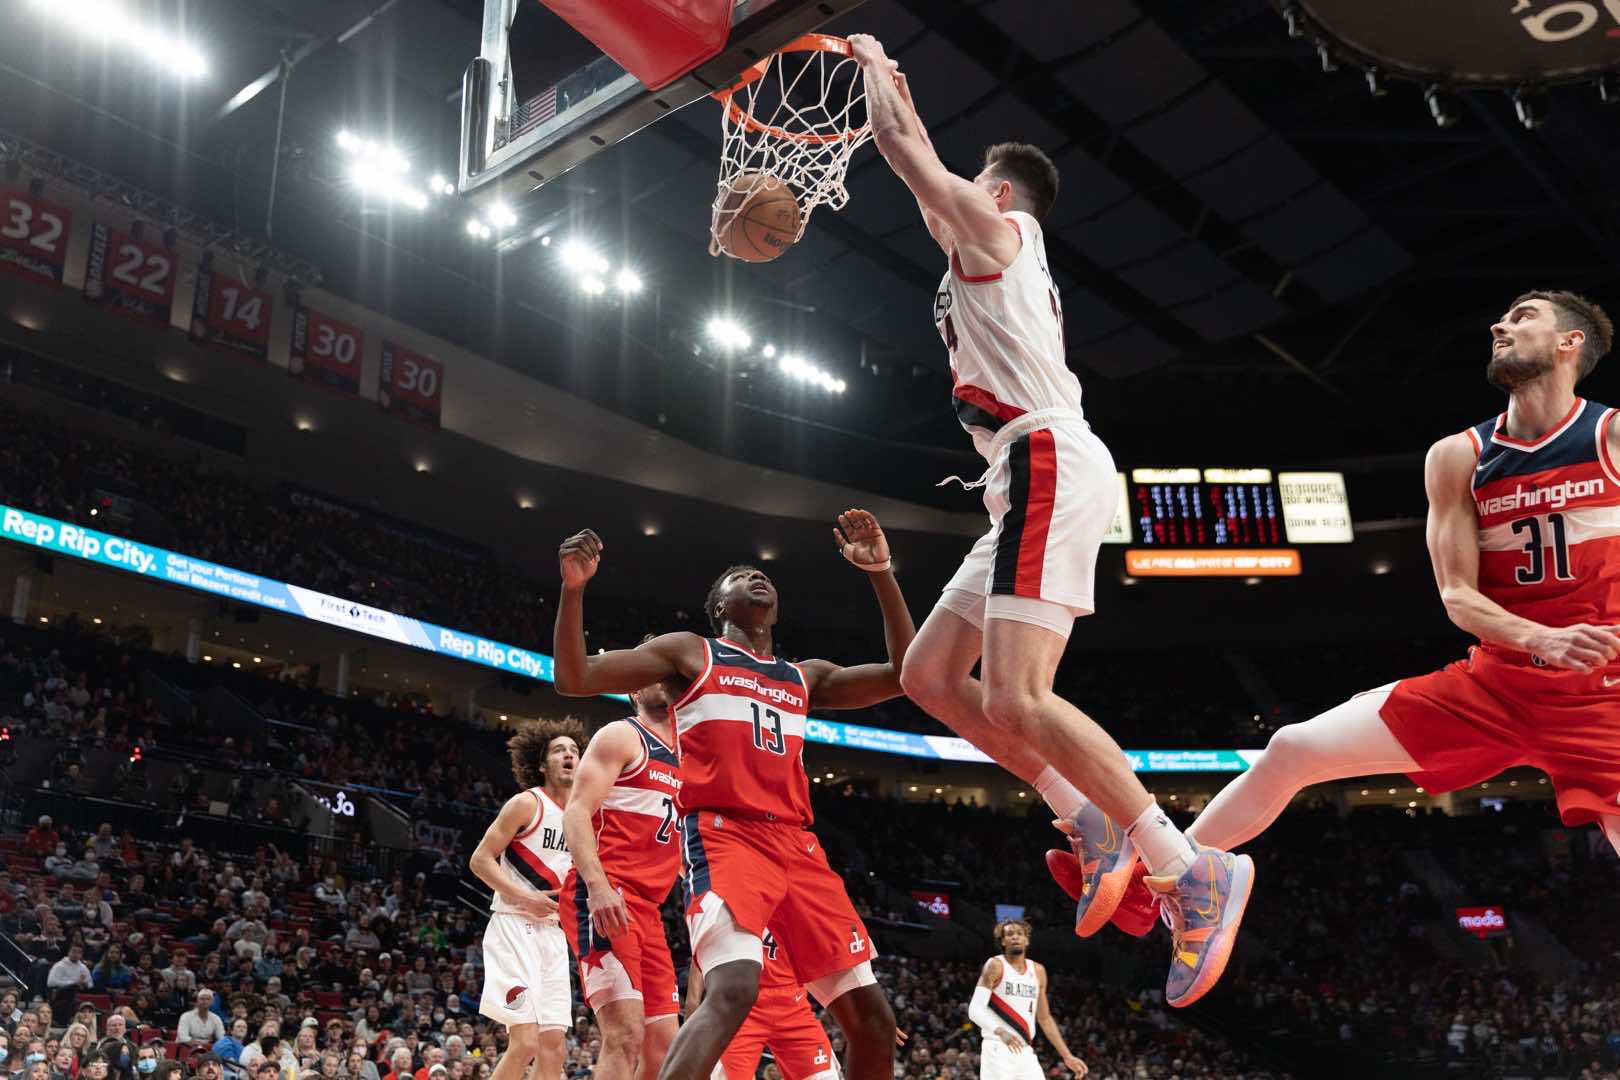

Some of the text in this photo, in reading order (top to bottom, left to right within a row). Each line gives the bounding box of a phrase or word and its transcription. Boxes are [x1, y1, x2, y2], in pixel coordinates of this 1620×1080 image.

[1, 199, 63, 252] 32
[112, 243, 170, 296] 22
[221, 287, 263, 330] 14
[312, 325, 356, 364] 30
[399, 360, 437, 397] 30
[1477, 479, 1605, 516] washington
[3, 508, 157, 574] Rep Rip City.
[1511, 512, 1576, 585] 31
[320, 598, 346, 614] First
[362, 609, 386, 625] Tech
[440, 628, 544, 677] Rep Rip City.
[719, 675, 803, 707] washington
[749, 701, 787, 755] 13
[806, 720, 841, 743] City.
[1459, 909, 1504, 928] moda
